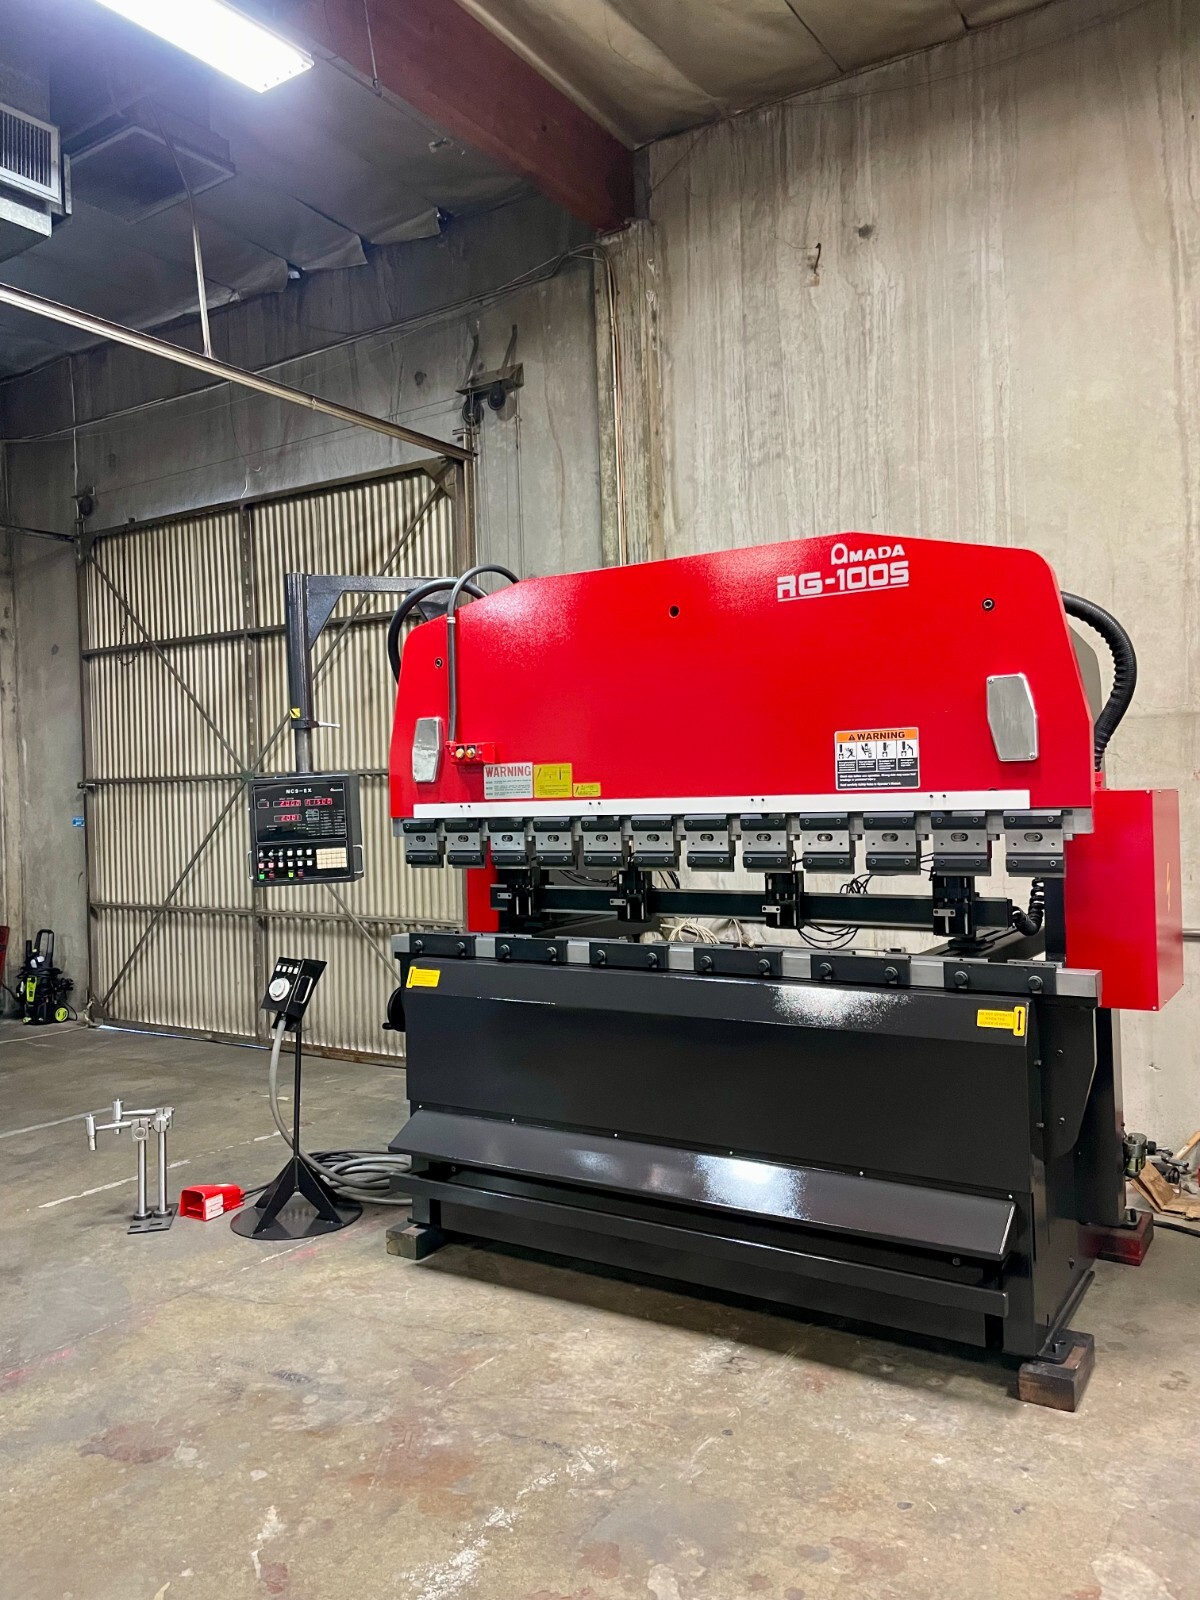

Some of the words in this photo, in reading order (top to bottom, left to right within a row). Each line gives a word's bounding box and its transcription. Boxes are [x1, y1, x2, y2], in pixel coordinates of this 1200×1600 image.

[831, 543, 905, 565] AMADA
[777, 561, 909, 599] RG-100S
[857, 731, 905, 741] WARNING
[485, 765, 532, 778] WARNING
